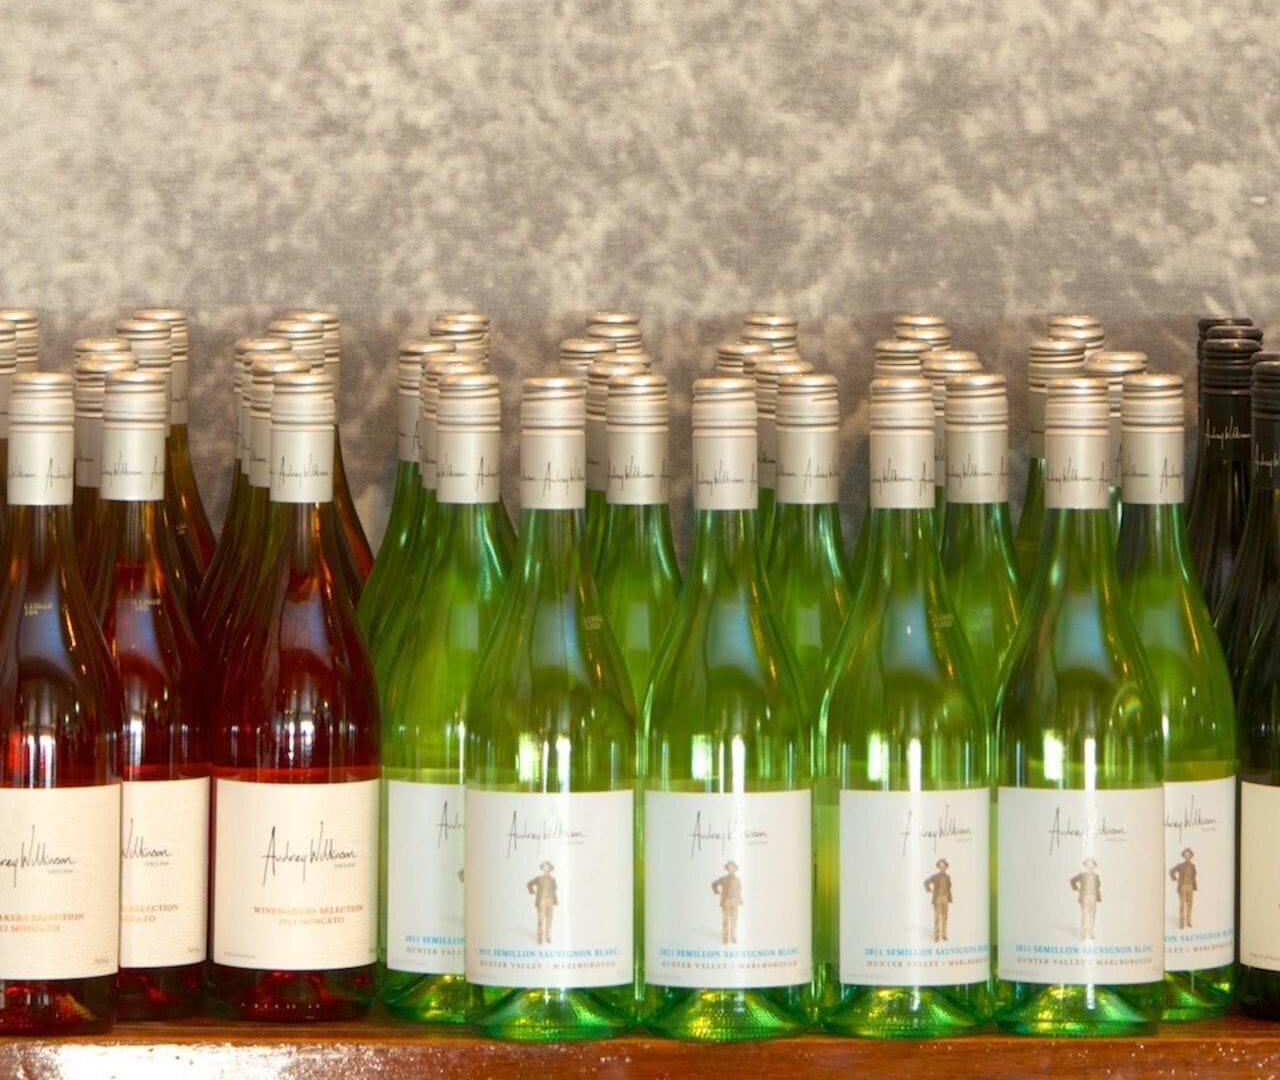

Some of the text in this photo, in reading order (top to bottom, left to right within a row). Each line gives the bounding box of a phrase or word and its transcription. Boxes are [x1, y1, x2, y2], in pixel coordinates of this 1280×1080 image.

[21, 823, 77, 868] Wilkinson
[261, 819, 359, 887] Audrey Wilkinson
[506, 809, 541, 860] Audrey
